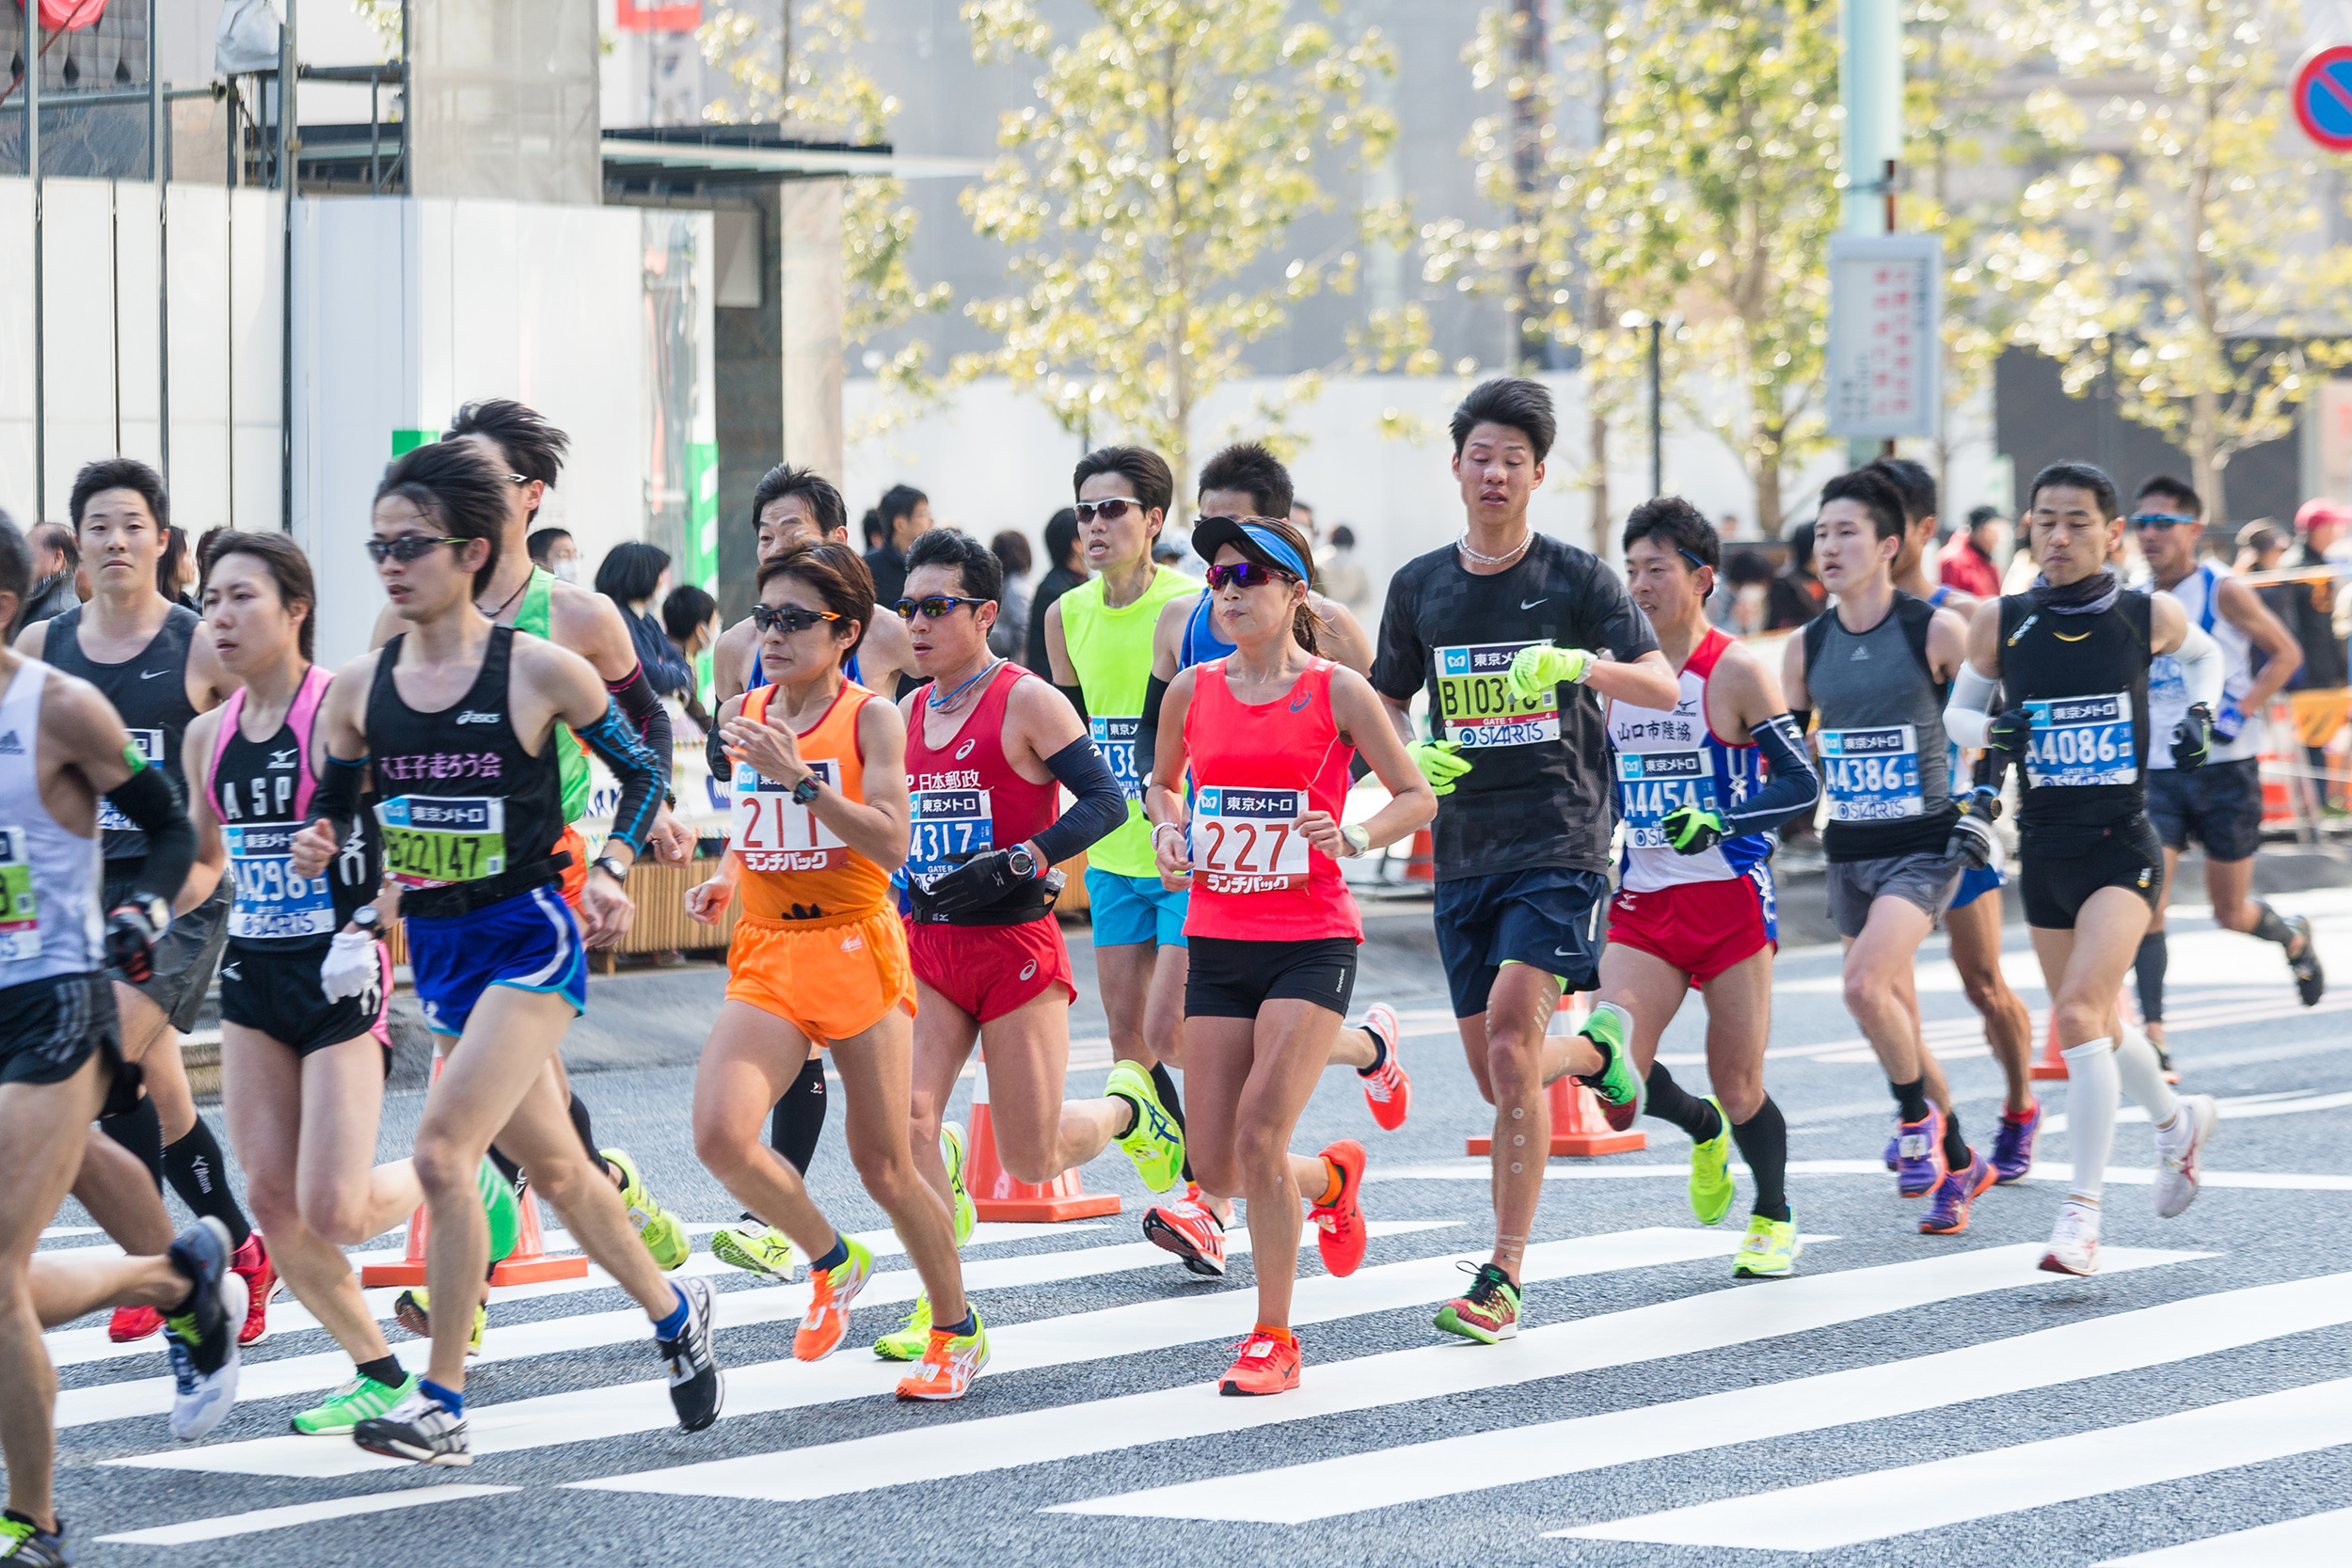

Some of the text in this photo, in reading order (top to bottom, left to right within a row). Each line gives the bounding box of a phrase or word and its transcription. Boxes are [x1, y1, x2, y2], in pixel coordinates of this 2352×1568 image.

[1473, 651, 1518, 667] 東京メ
[1441, 677, 1537, 715] B103
[1483, 718, 1505, 726] GATE
[2052, 704, 2117, 721] 東京メトロ
[1109, 723, 1139, 736] 東京メ
[1617, 721, 1692, 742] 山口市陸協
[1843, 736, 1900, 750] 東京メトロ
[2025, 725, 2118, 766] A4086
[1645, 758, 1697, 772] 東京メトロ
[1825, 757, 1903, 793] A4386
[919, 769, 981, 790] 日本郵政
[921, 799, 977, 813] 東京メトロ
[1226, 797, 1294, 812] 東京メトロ
[1624, 781, 1700, 817] A4454
[411, 806, 485, 823] 東京メトロ
[741, 798, 818, 848] 211
[245, 833, 294, 848] 東京メト
[906, 823, 973, 863] 4317
[1205, 821, 1289, 873] 227
[745, 851, 828, 871] ランチパック
[1207, 874, 1289, 894] ランチパック
[1336, 968, 1345, 993] Reebok
